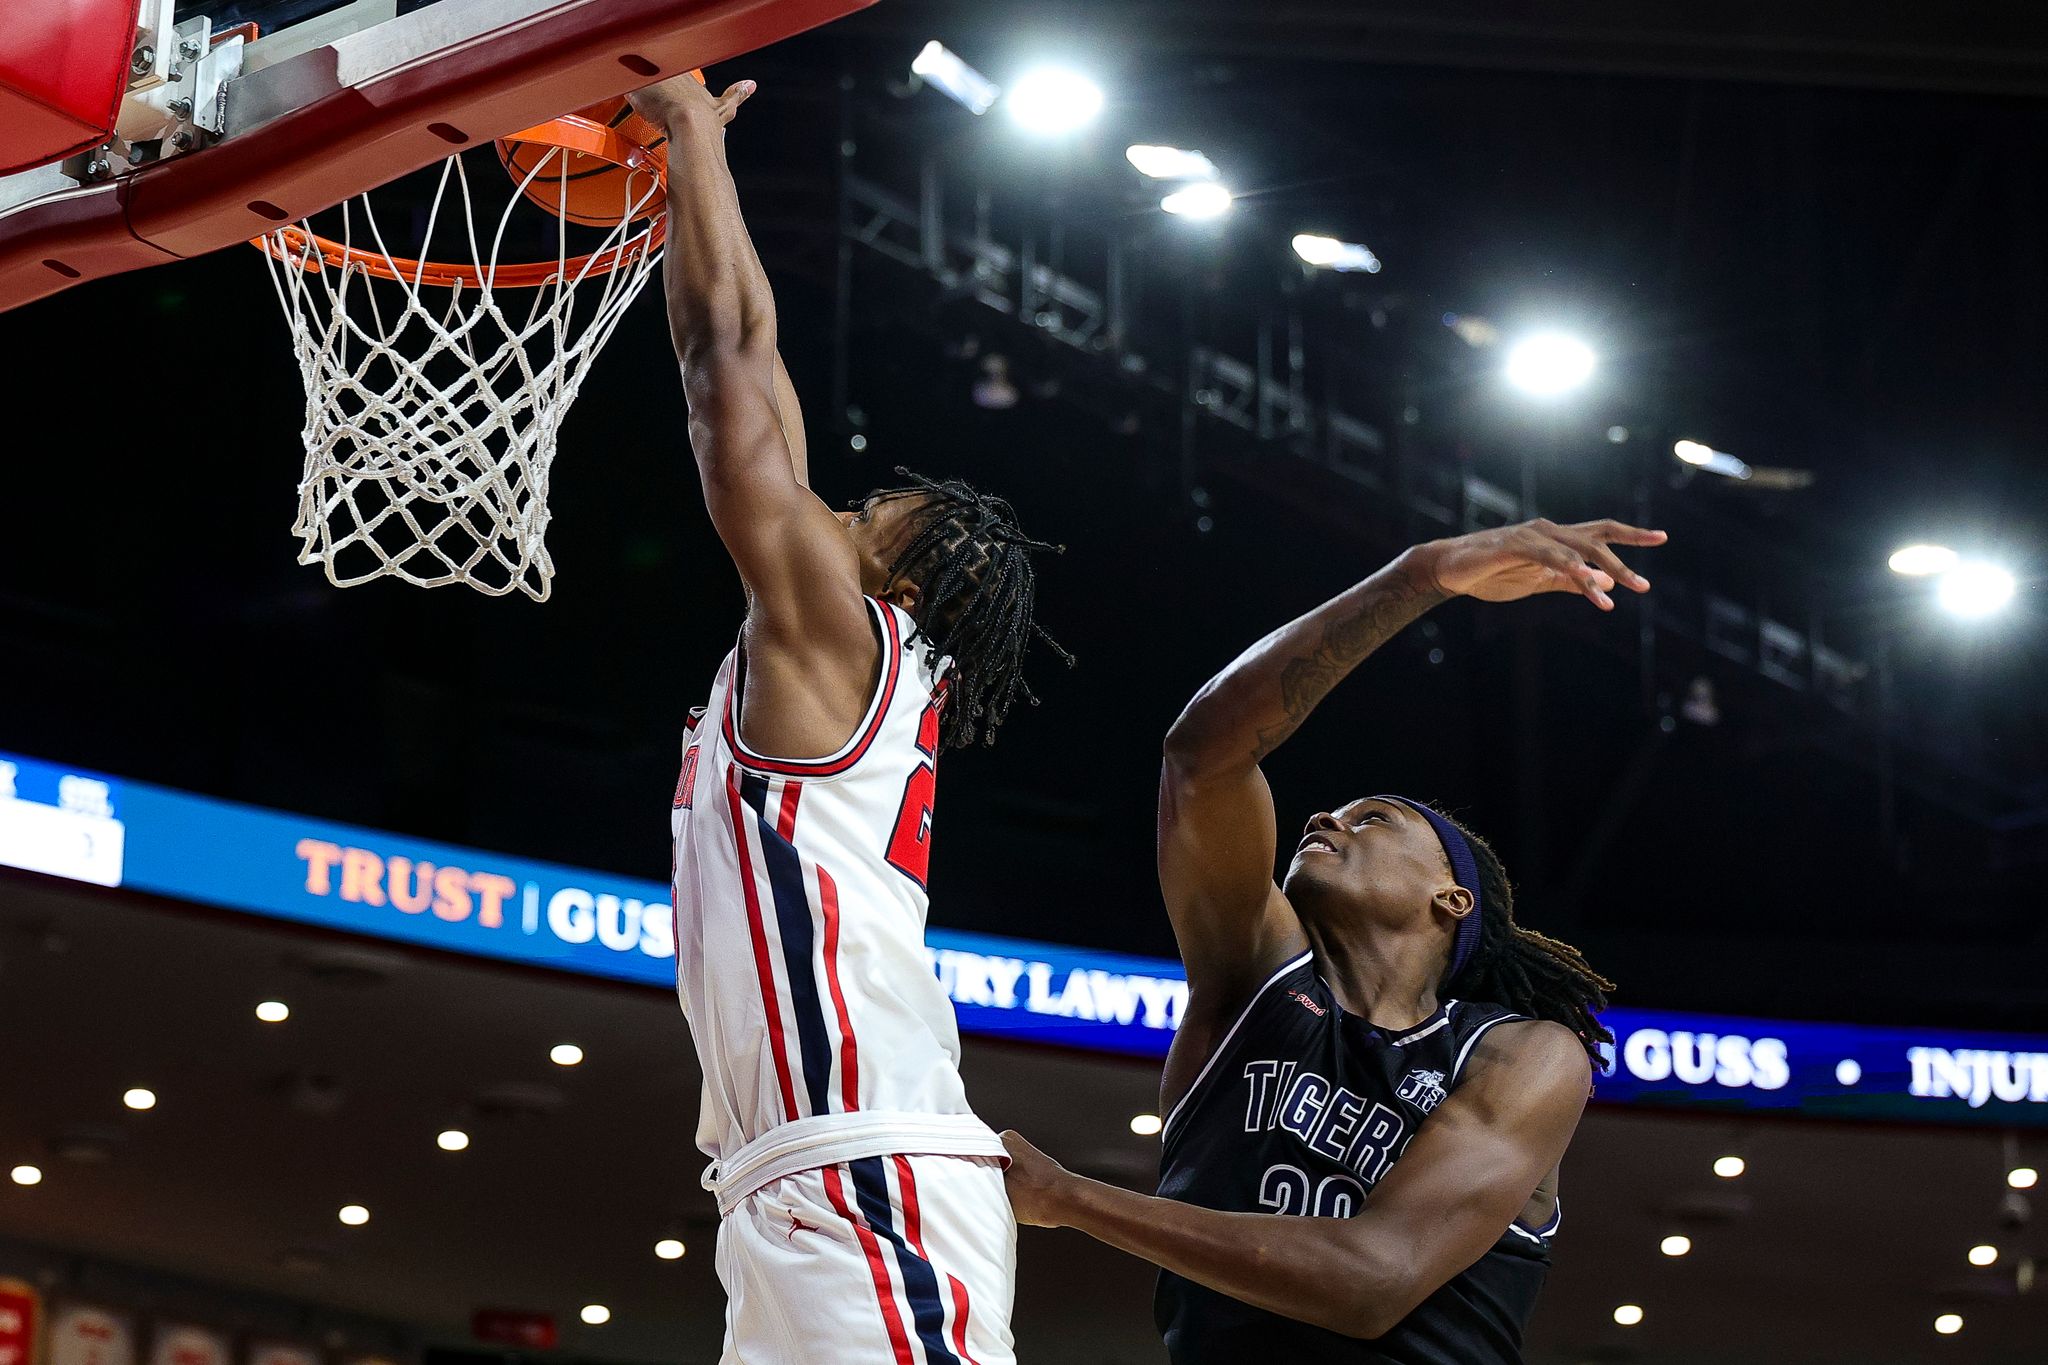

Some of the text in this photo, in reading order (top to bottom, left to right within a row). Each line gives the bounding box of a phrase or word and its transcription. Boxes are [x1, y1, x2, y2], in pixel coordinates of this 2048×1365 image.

[296, 838, 517, 929] TRUST
[1623, 1027, 1790, 1091] GUSS
[1243, 1060, 1414, 1185] TIGER
